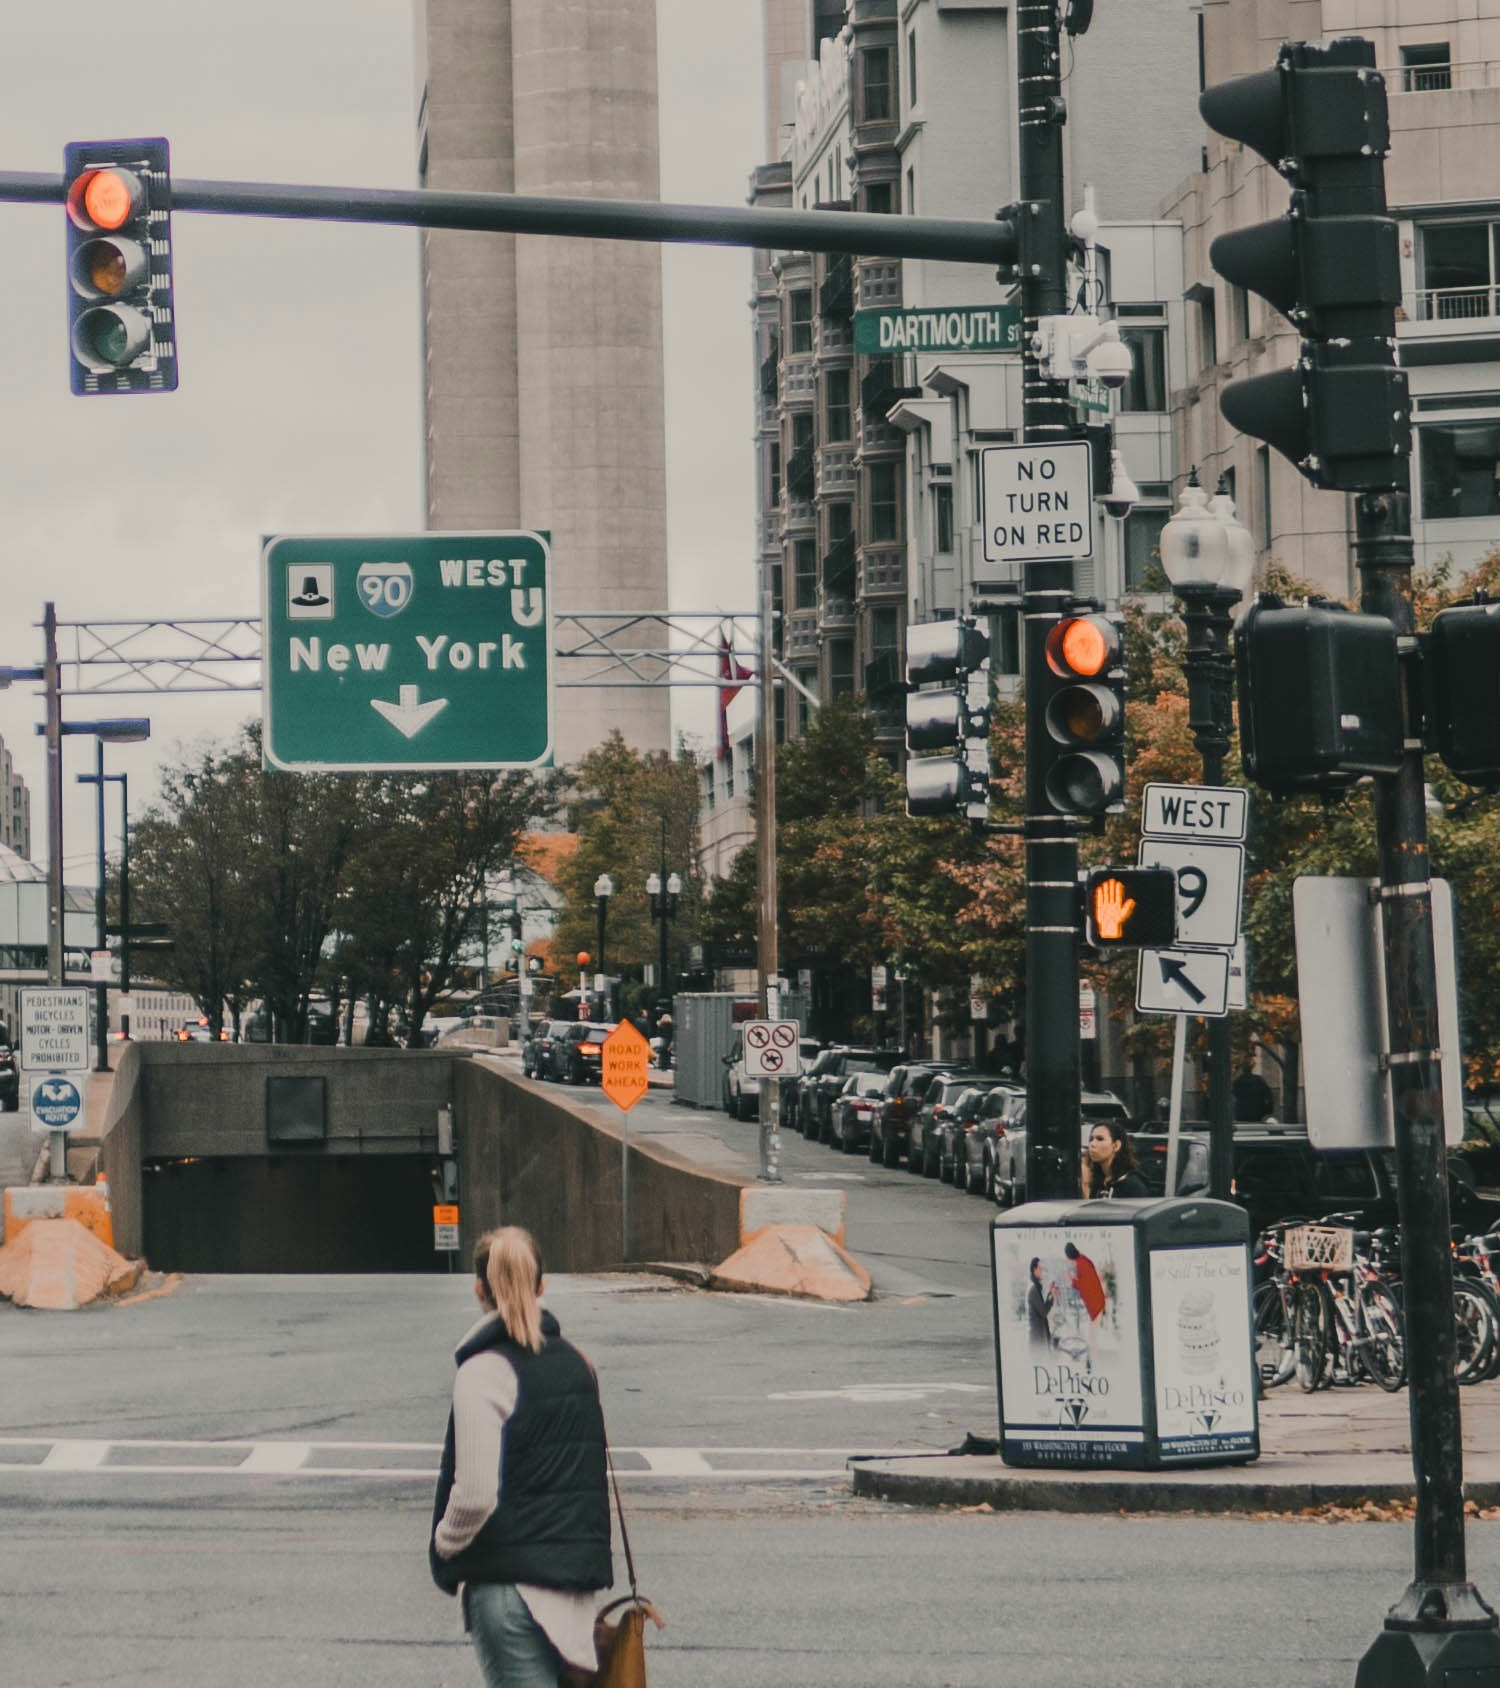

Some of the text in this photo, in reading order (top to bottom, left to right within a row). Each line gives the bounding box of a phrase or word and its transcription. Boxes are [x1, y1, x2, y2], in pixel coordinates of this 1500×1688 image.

[879, 312, 1020, 348] DARTMOUTH ST
[1018, 459, 1055, 480] NO
[1006, 491, 1068, 514] TURN
[994, 522, 1083, 546] ON RED
[362, 576, 406, 606] 90
[439, 559, 527, 586] WEST
[290, 634, 526, 671] New York
[1160, 795, 1231, 828] WEST
[1177, 865, 1207, 919] 9
[26, 995, 83, 1007] PEDESTRIANS
[34, 1010, 75, 1021] BICYCLES
[39, 1039, 71, 1048] CYCLES
[608, 1044, 641, 1055] ROAD
[31, 1052, 80, 1062] PROHIBITED
[609, 1060, 640, 1071] WORK
[606, 1076, 646, 1087] AHEAD
[36, 1106, 78, 1115] EVACUATION
[1034, 1365, 1109, 1396] DePrisco
[1165, 1385, 1244, 1410] DePrisco
